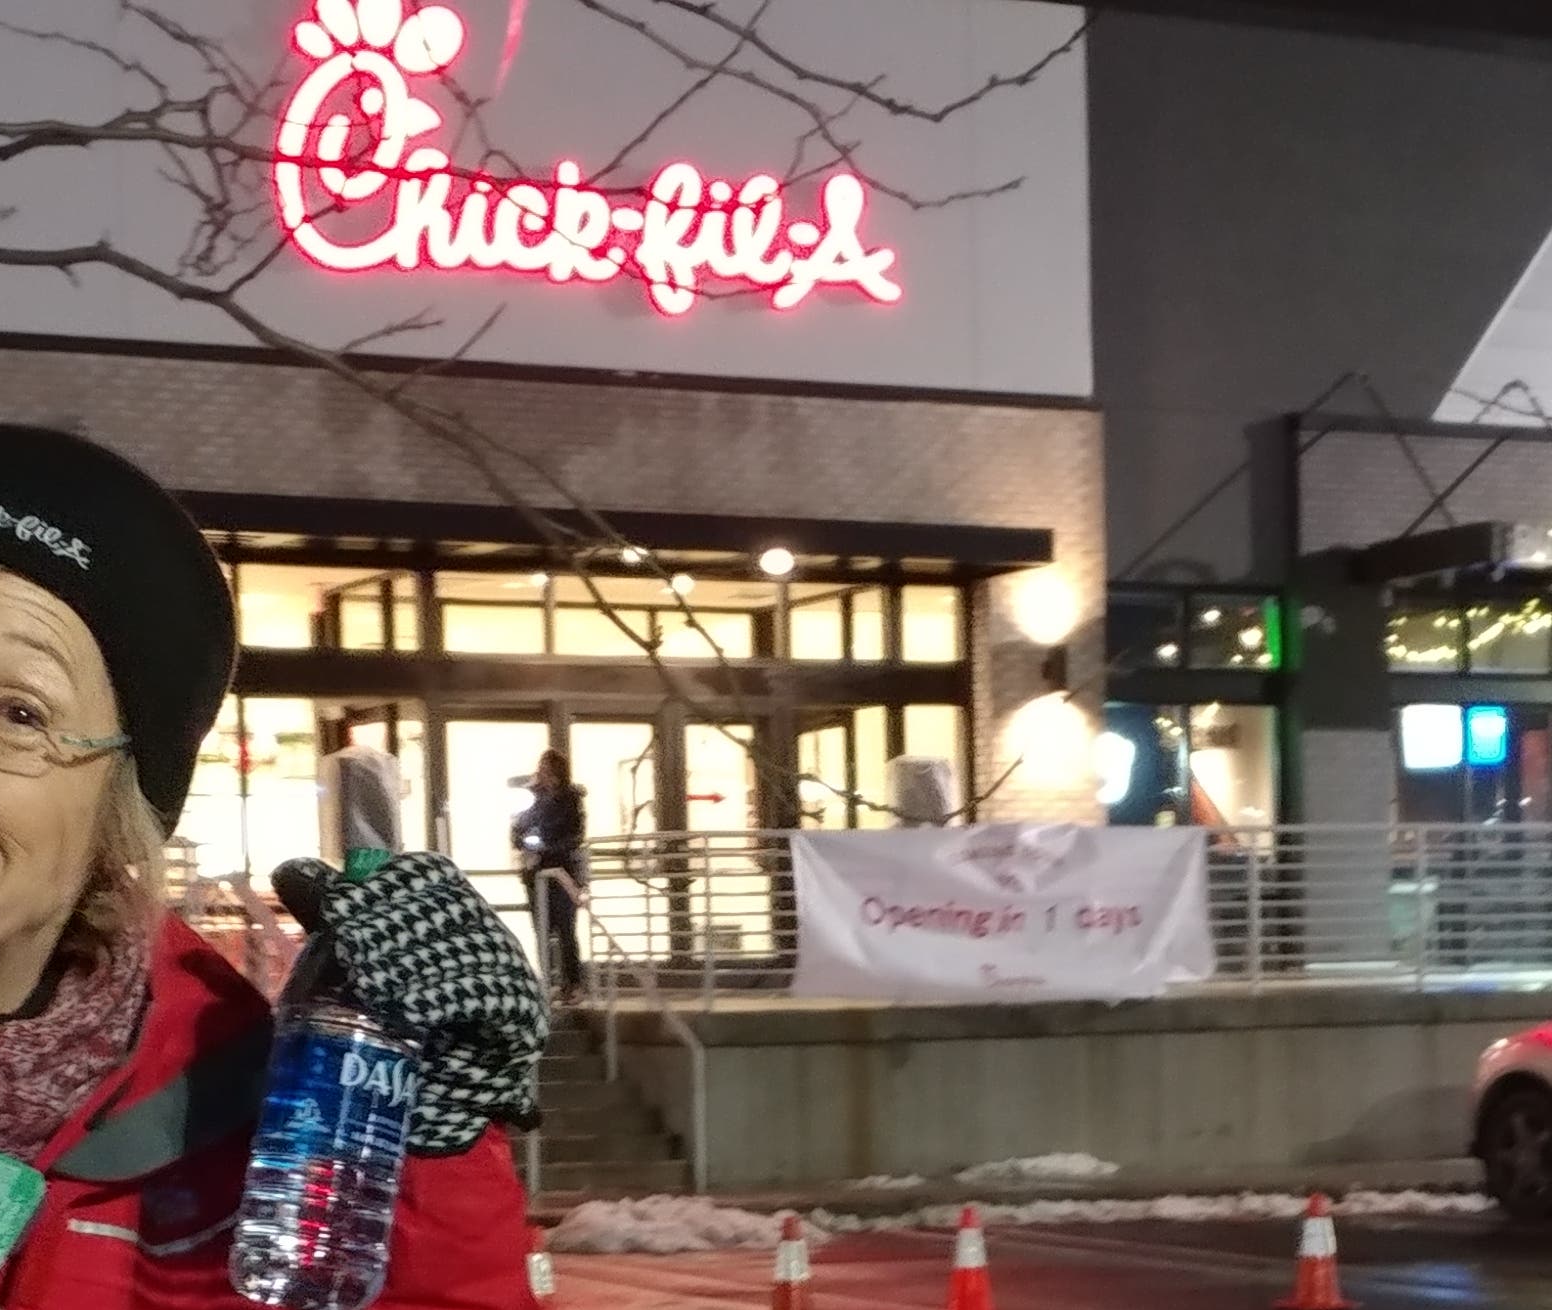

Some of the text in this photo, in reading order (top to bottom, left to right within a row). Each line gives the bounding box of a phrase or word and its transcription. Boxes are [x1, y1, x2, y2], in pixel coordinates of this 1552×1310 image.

[275, 45, 903, 313] Chick-fil-A
[859, 896, 994, 938] Opening
[996, 904, 1026, 933] in
[1075, 902, 1142, 936] days
